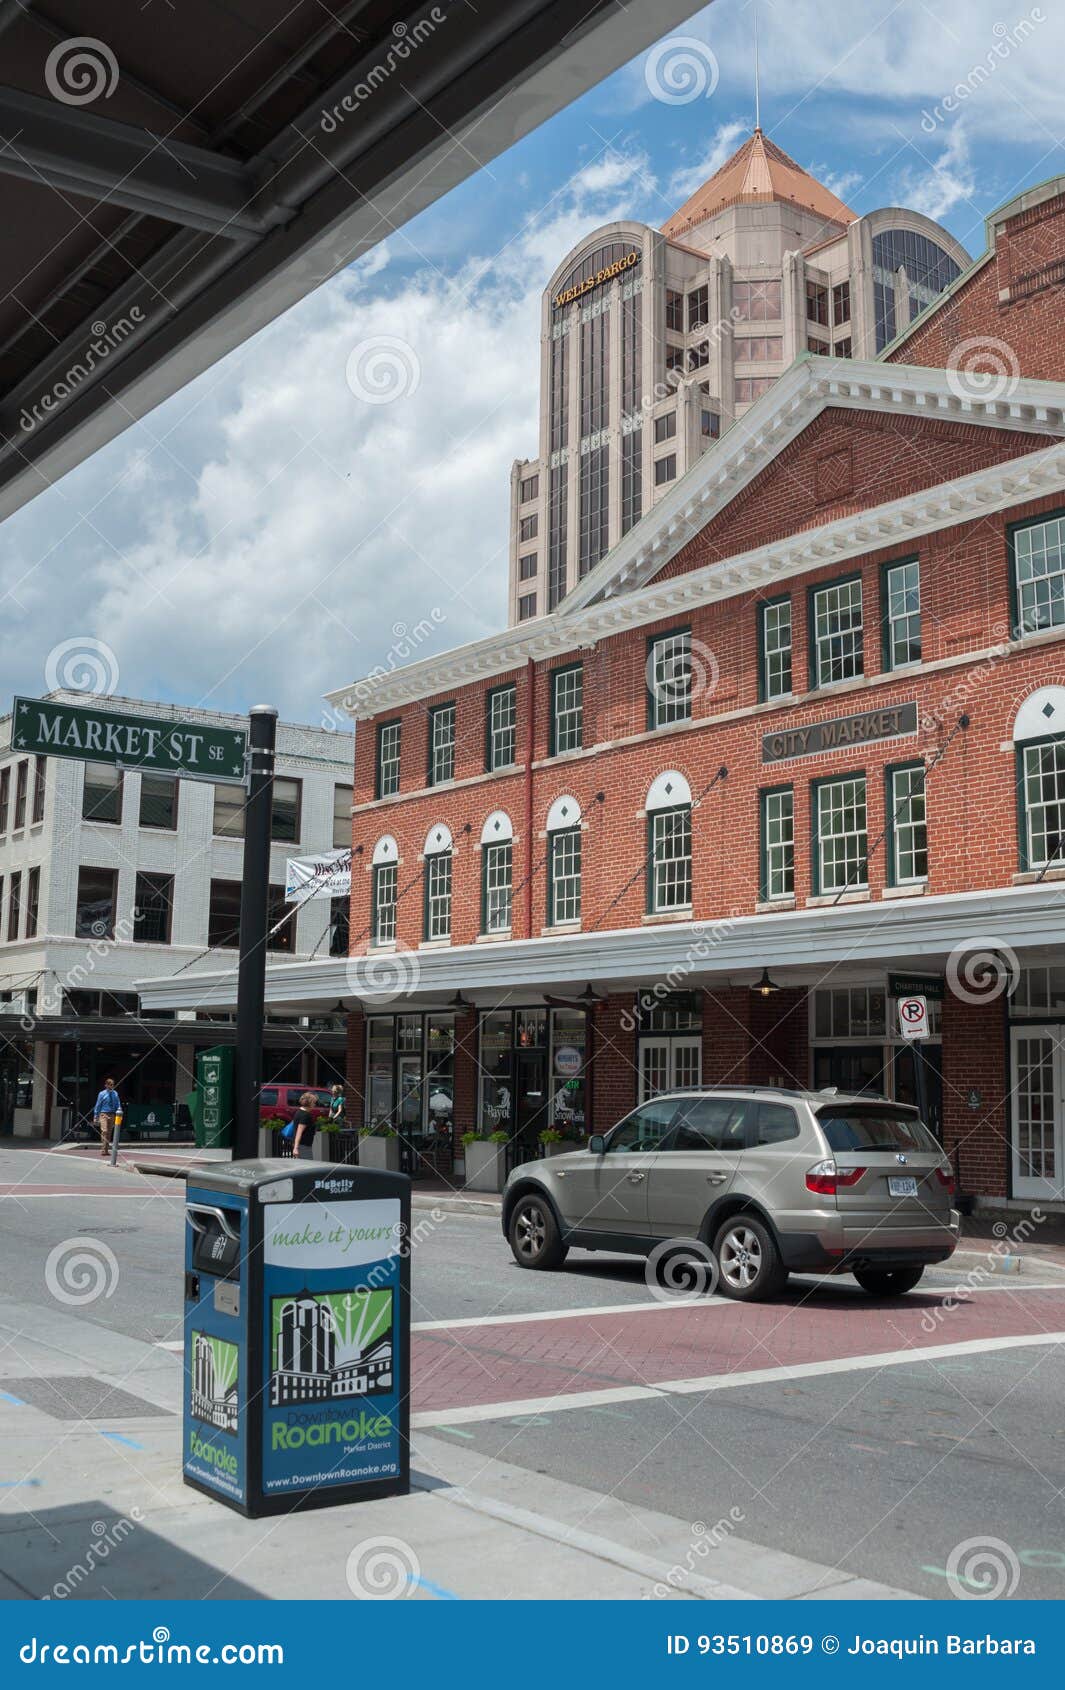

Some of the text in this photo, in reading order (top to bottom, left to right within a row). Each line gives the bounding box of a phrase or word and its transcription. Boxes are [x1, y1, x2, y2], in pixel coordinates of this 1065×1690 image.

[555, 252, 637, 307] WELLS FARGO
[37, 712, 225, 763] MARKET ST SE
[772, 711, 902, 757] CITY MARKET
[895, 982, 939, 992] CHARTER HALL
[315, 1180, 354, 1190] BigBelly
[273, 1224, 392, 1253] make it yours
[271, 1411, 392, 1451] Roanoke
[288, 1408, 363, 1426] Downtown
[190, 1431, 238, 1475] Roanoke
[368, 1442, 391, 1451] District
[266, 1462, 397, 1488] www.DowntownRoanoke.org
